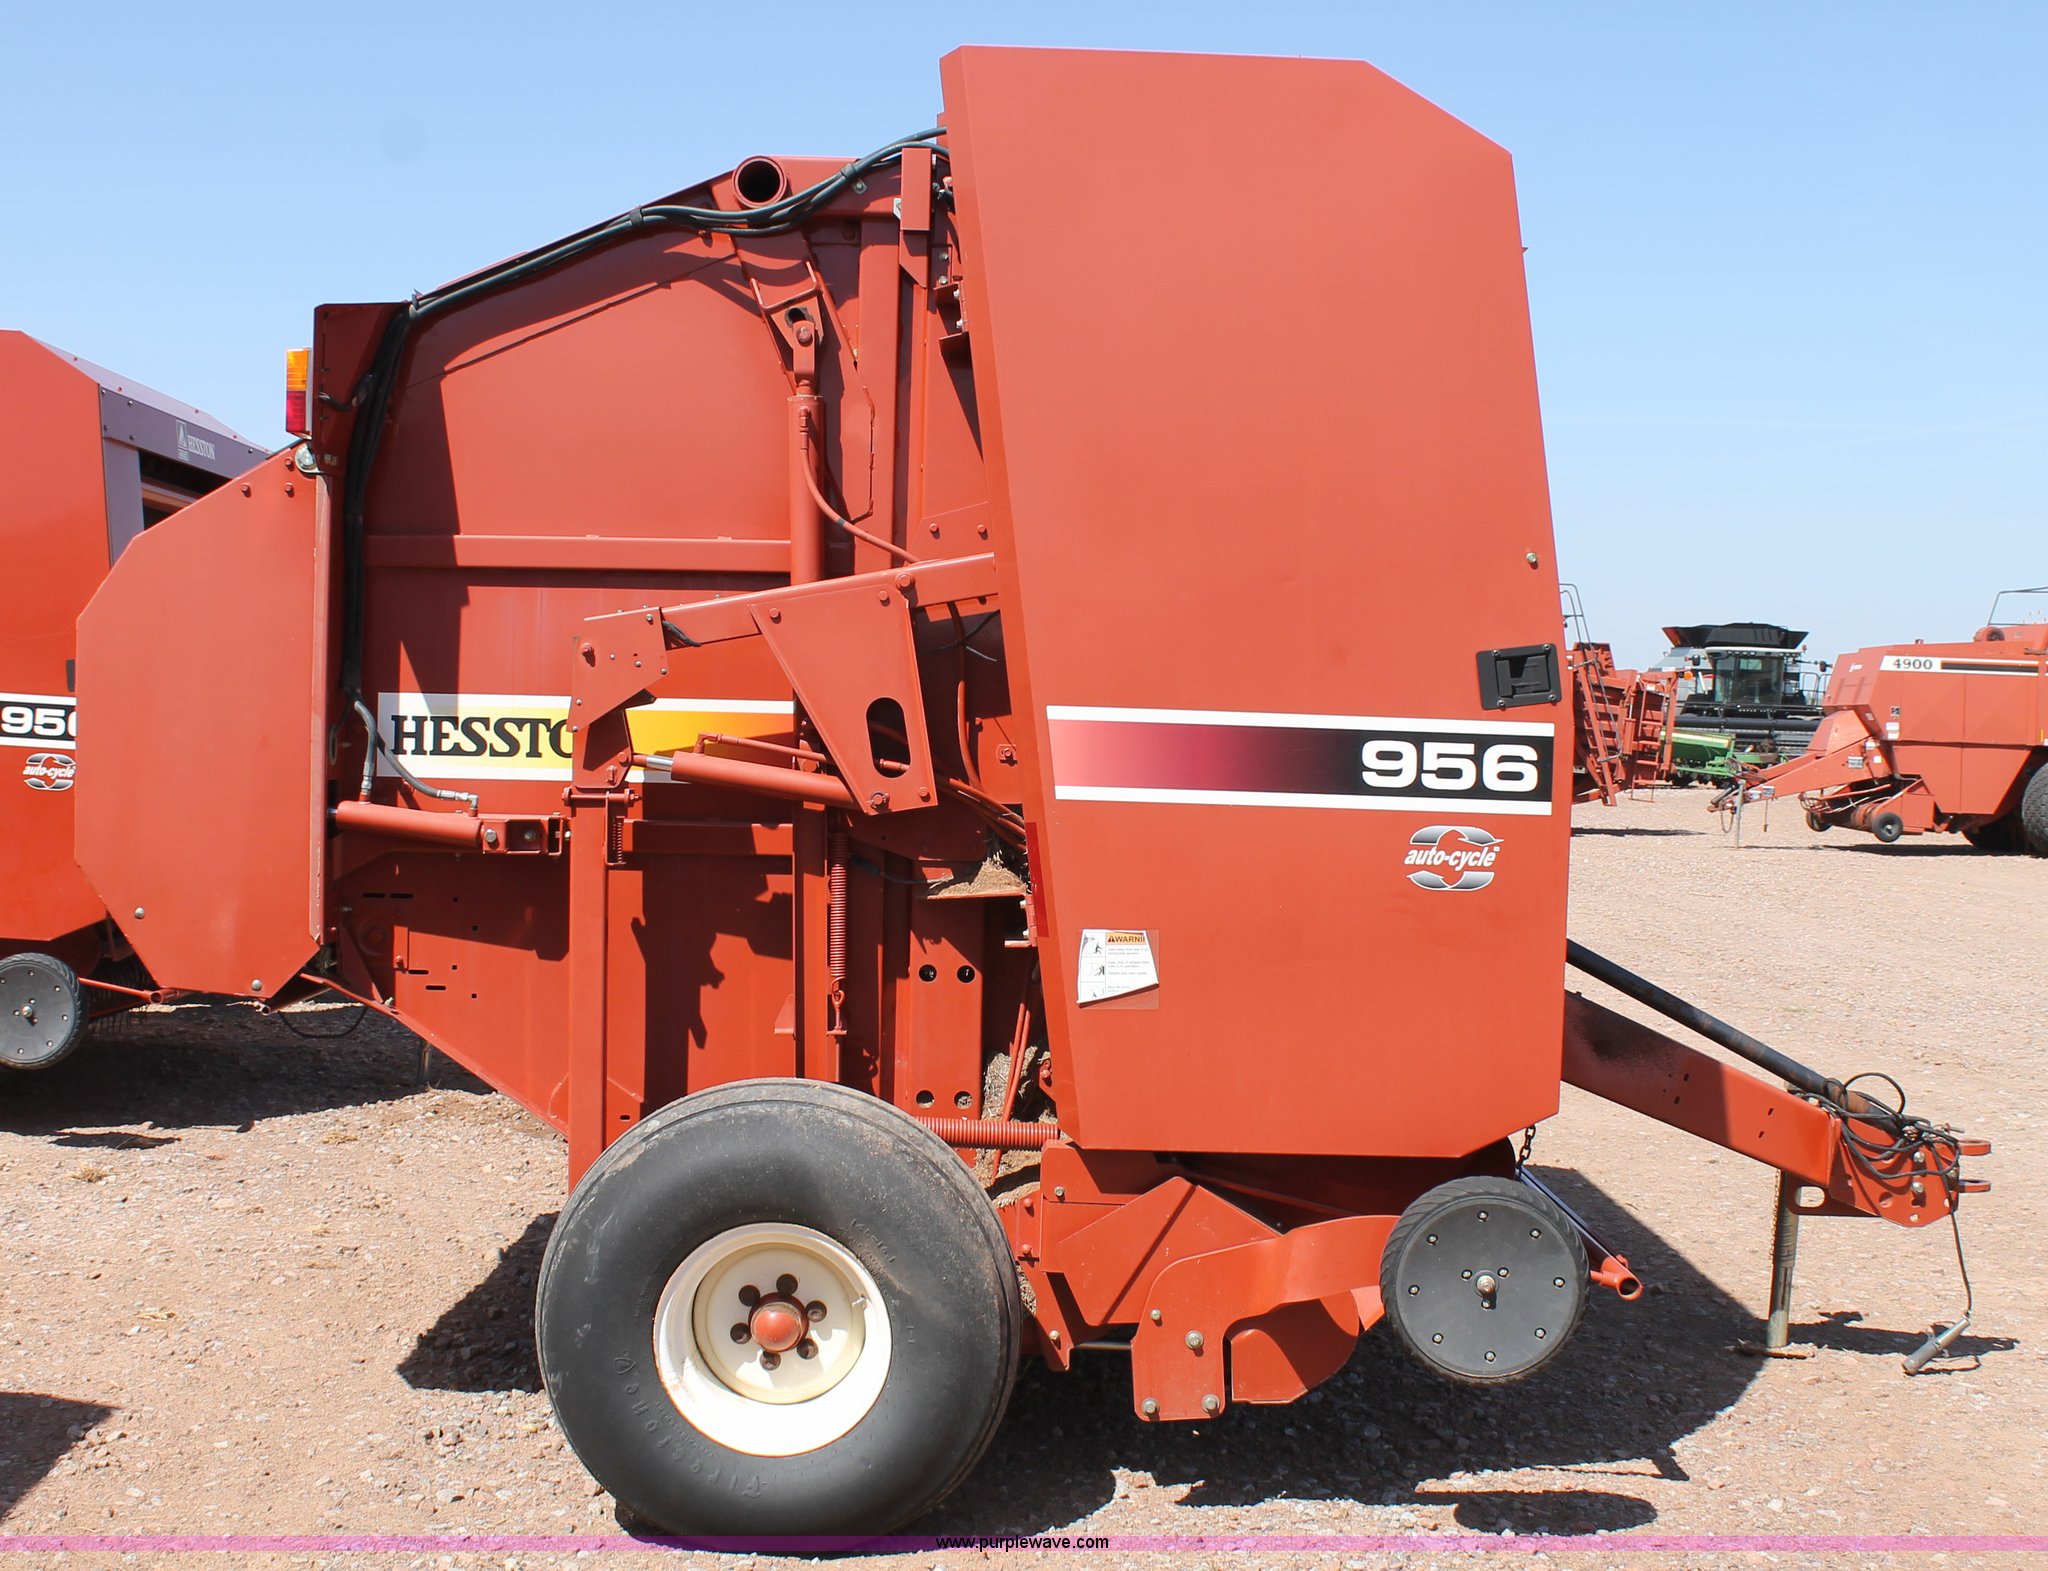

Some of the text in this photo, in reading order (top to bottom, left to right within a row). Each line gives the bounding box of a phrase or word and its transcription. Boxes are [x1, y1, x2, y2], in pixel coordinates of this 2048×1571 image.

[1893, 658, 1933, 670] 4900
[1, 706, 77, 737] 95
[22, 765, 75, 779] auto-cycle
[1362, 740, 1538, 792] 956
[1404, 846, 1497, 871] auto-cycle
